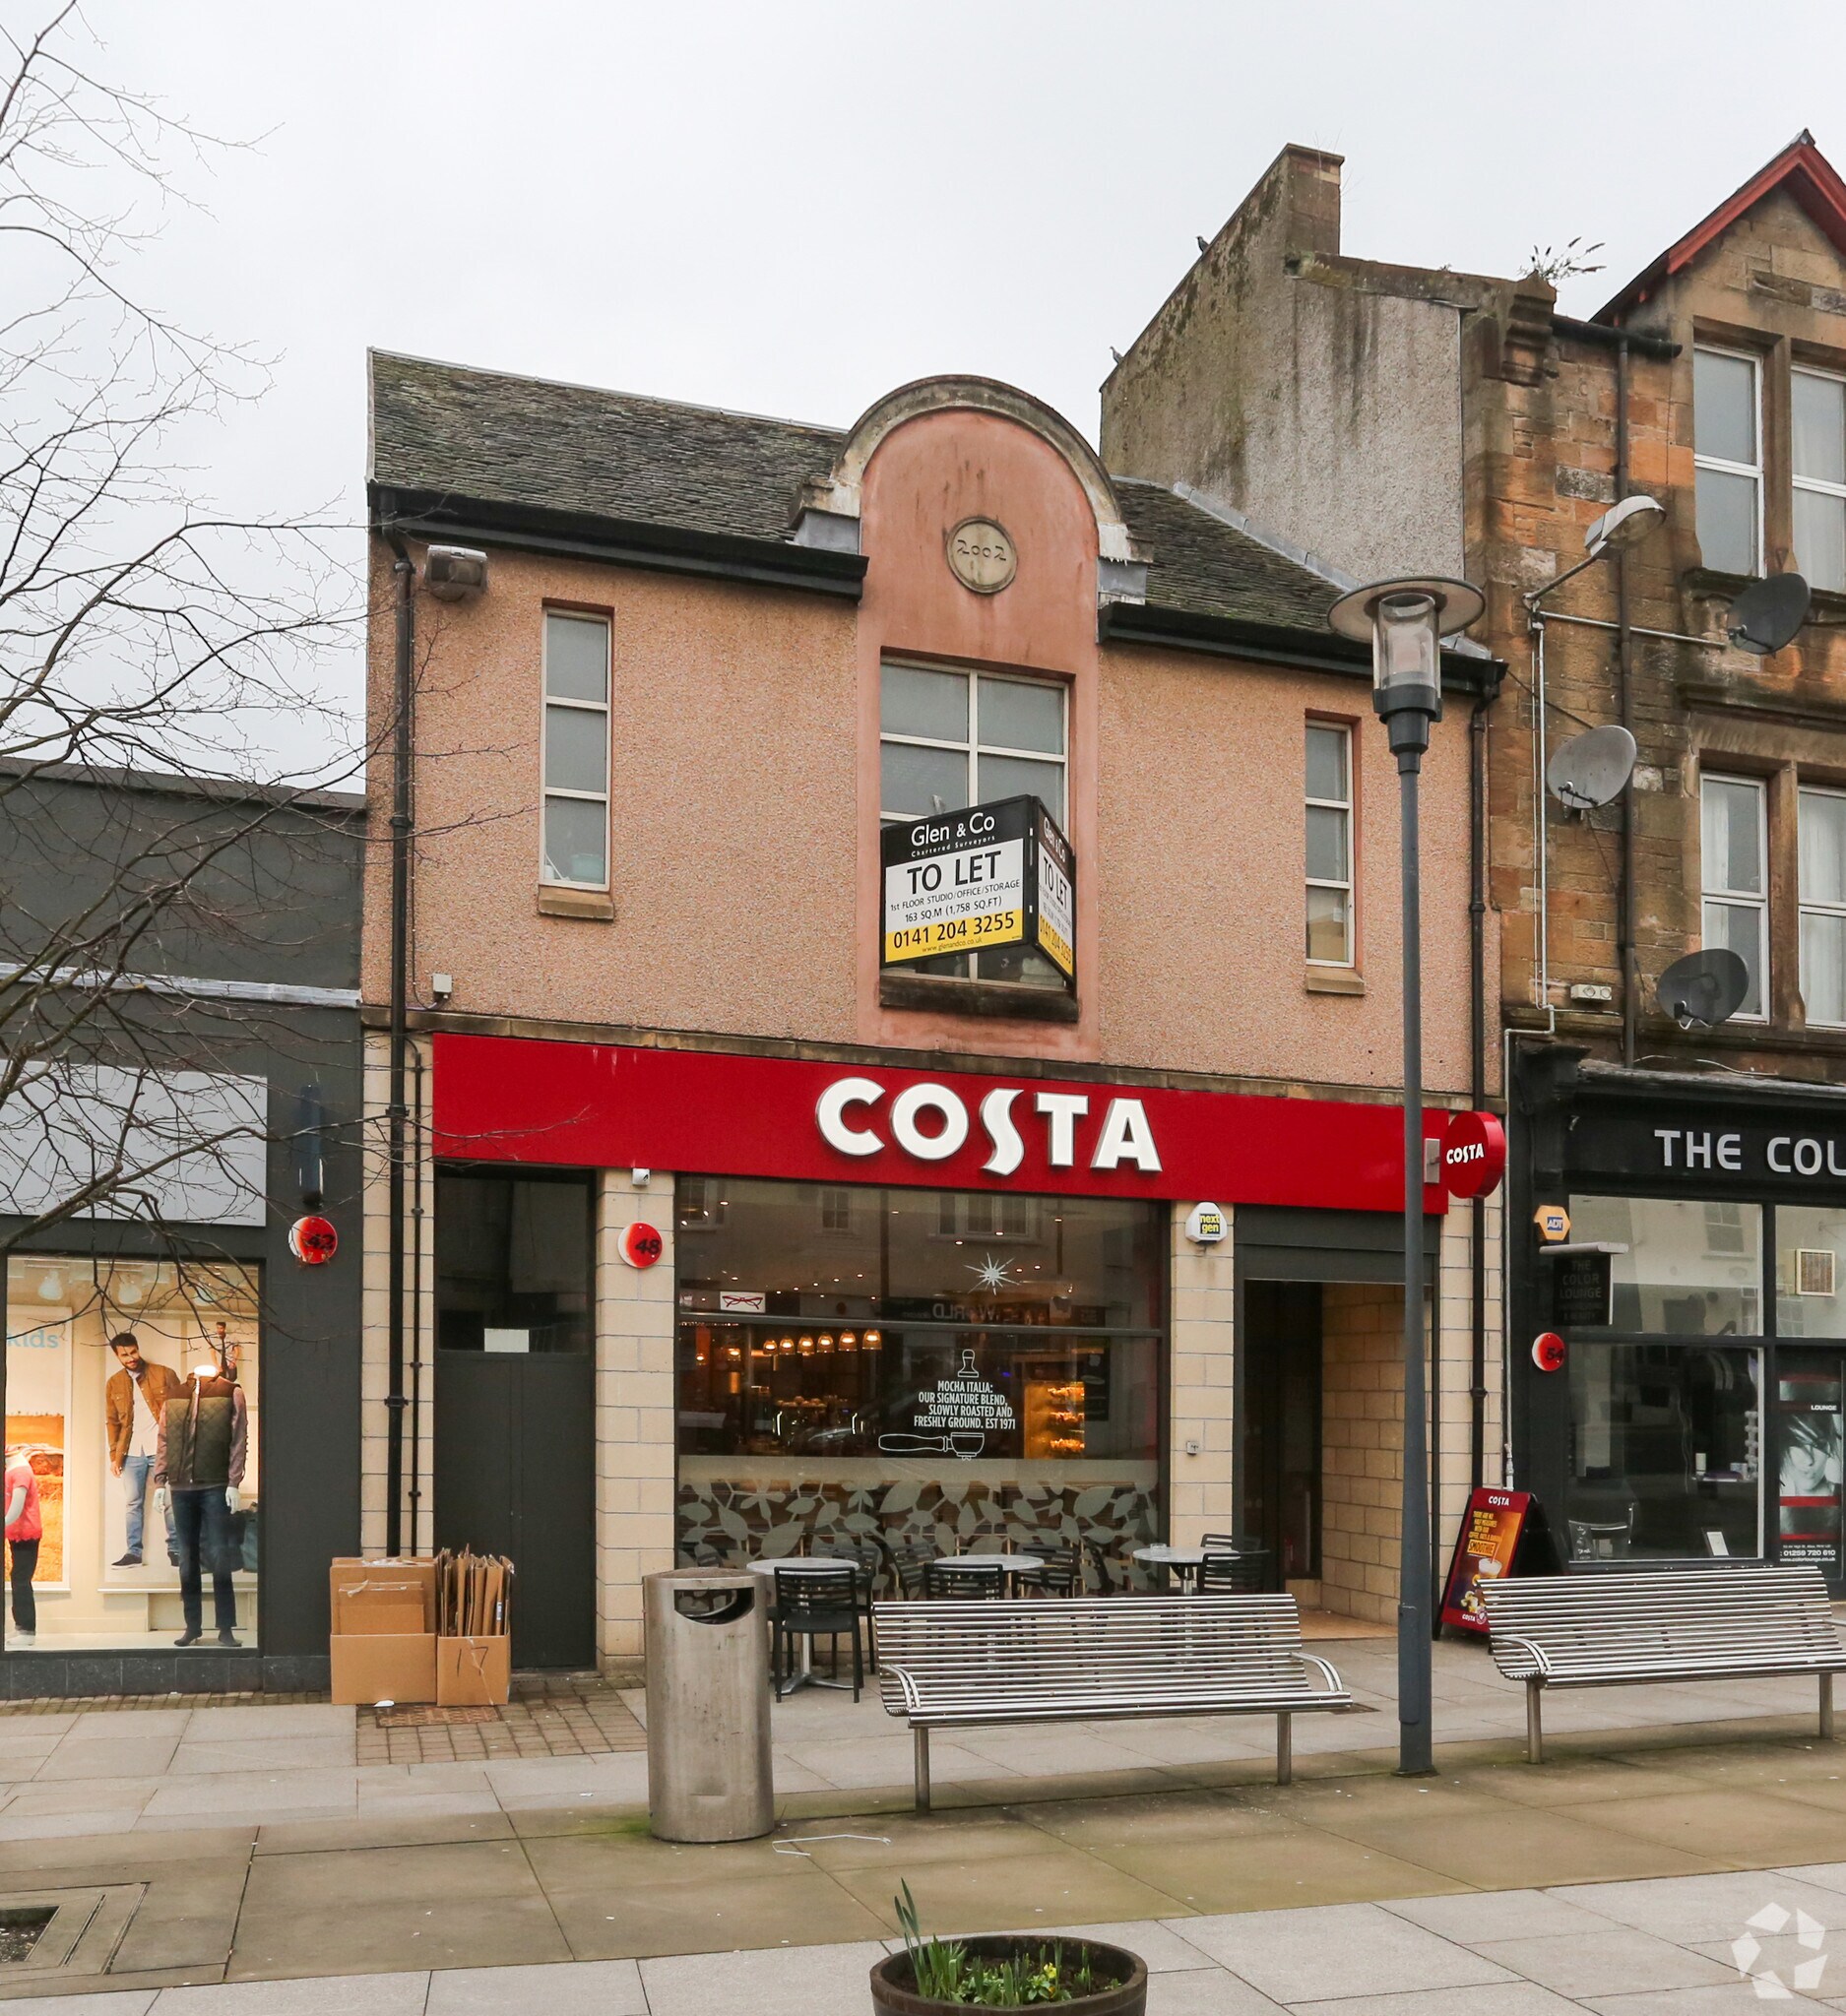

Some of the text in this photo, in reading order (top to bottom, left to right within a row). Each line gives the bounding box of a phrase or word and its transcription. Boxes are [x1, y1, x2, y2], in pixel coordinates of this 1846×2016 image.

[957, 539, 1006, 561] 2002
[912, 812, 995, 847] Glen & Co
[912, 836, 995, 857] Chartered Surveyors
[907, 850, 1001, 895] TO LET
[1044, 856, 1067, 911] TO LET
[890, 903, 900, 912] 1st
[902, 897, 924, 910] FLOOR
[905, 896, 1002, 923] 163 SQ.M (1,758 SQ.FT)
[894, 912, 1014, 949] 0141 204 3255
[922, 936, 983, 953] www.glenandco.co.uk
[815, 1076, 1163, 1175] COSTA
[1446, 1143, 1485, 1165] COSTA
[1654, 1129, 1742, 1170] THE
[1200, 1214, 1220, 1223] next
[1547, 1219, 1563, 1229] ADT
[1201, 1224, 1219, 1234] gen
[634, 1238, 662, 1255] 48
[1562, 1274, 1600, 1286] COLOR
[1560, 1288, 1603, 1299] LOUNGE
[937, 1380, 993, 1394] MOCHA ITALIA:
[918, 1392, 1008, 1407] OUR SIGNATURE BLEND,
[928, 1404, 1013, 1418] SLOWLY ROASTED AND
[914, 1416, 1016, 1429] FRESHLY GROUND. EST 1971
[1488, 1495, 1510, 1506] COSTA
[456, 1646, 489, 1677] 17
